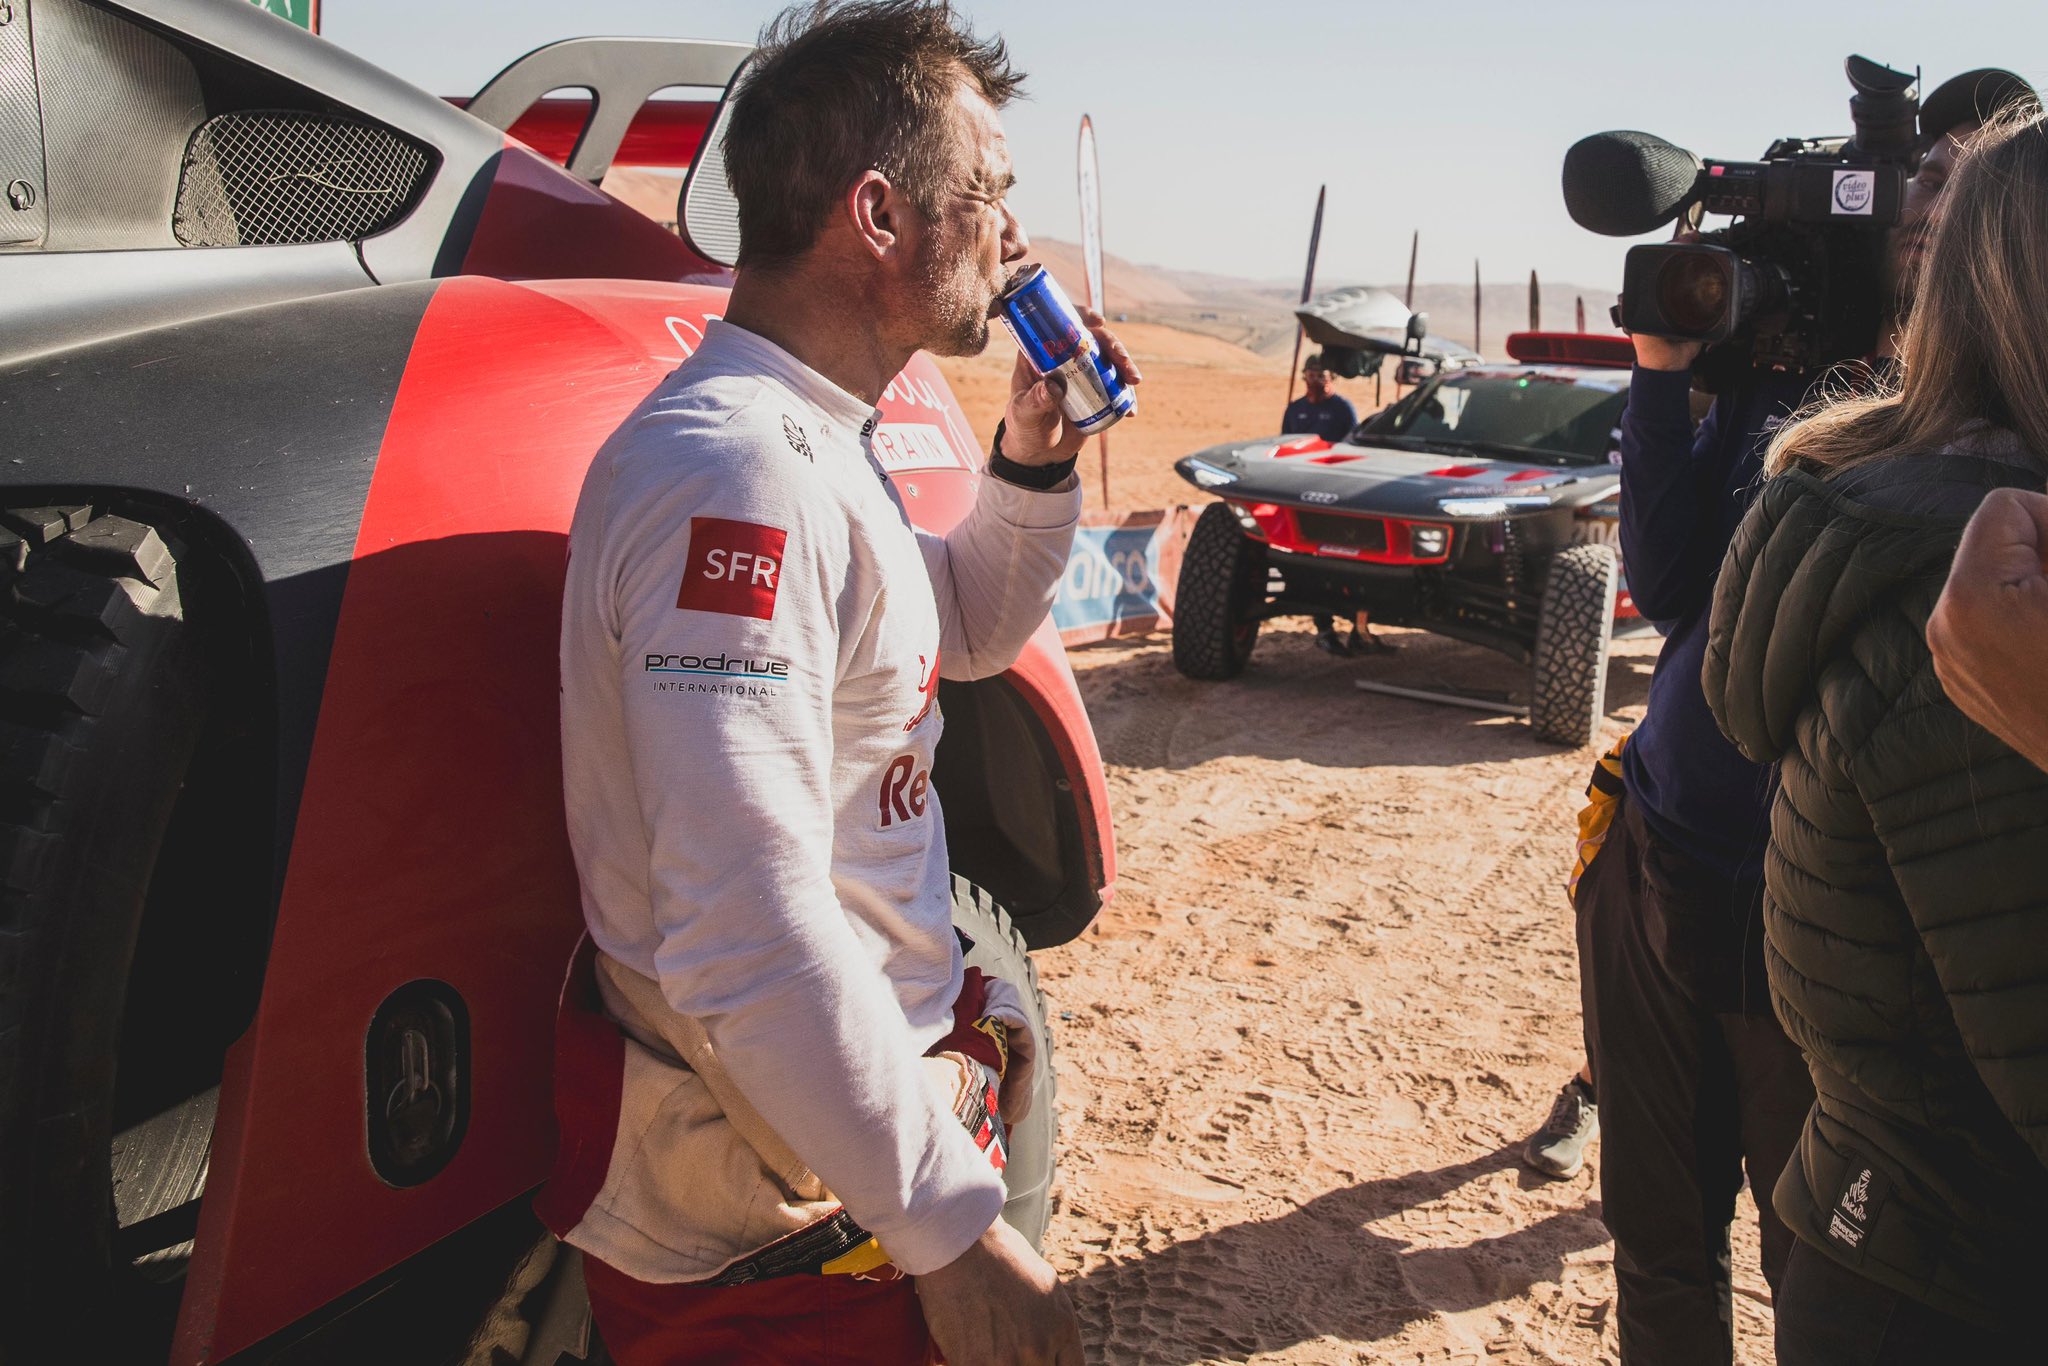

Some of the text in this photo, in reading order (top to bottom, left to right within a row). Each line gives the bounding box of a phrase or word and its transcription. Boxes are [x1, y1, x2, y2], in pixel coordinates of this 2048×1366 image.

[1845, 192, 1867, 205] plus
[1065, 357, 1092, 379] ENERG
[703, 549, 777, 589] SFR
[645, 653, 789, 676] prodrive
[653, 681, 777, 697] INTERNATIONAL
[879, 754, 928, 827] Re
